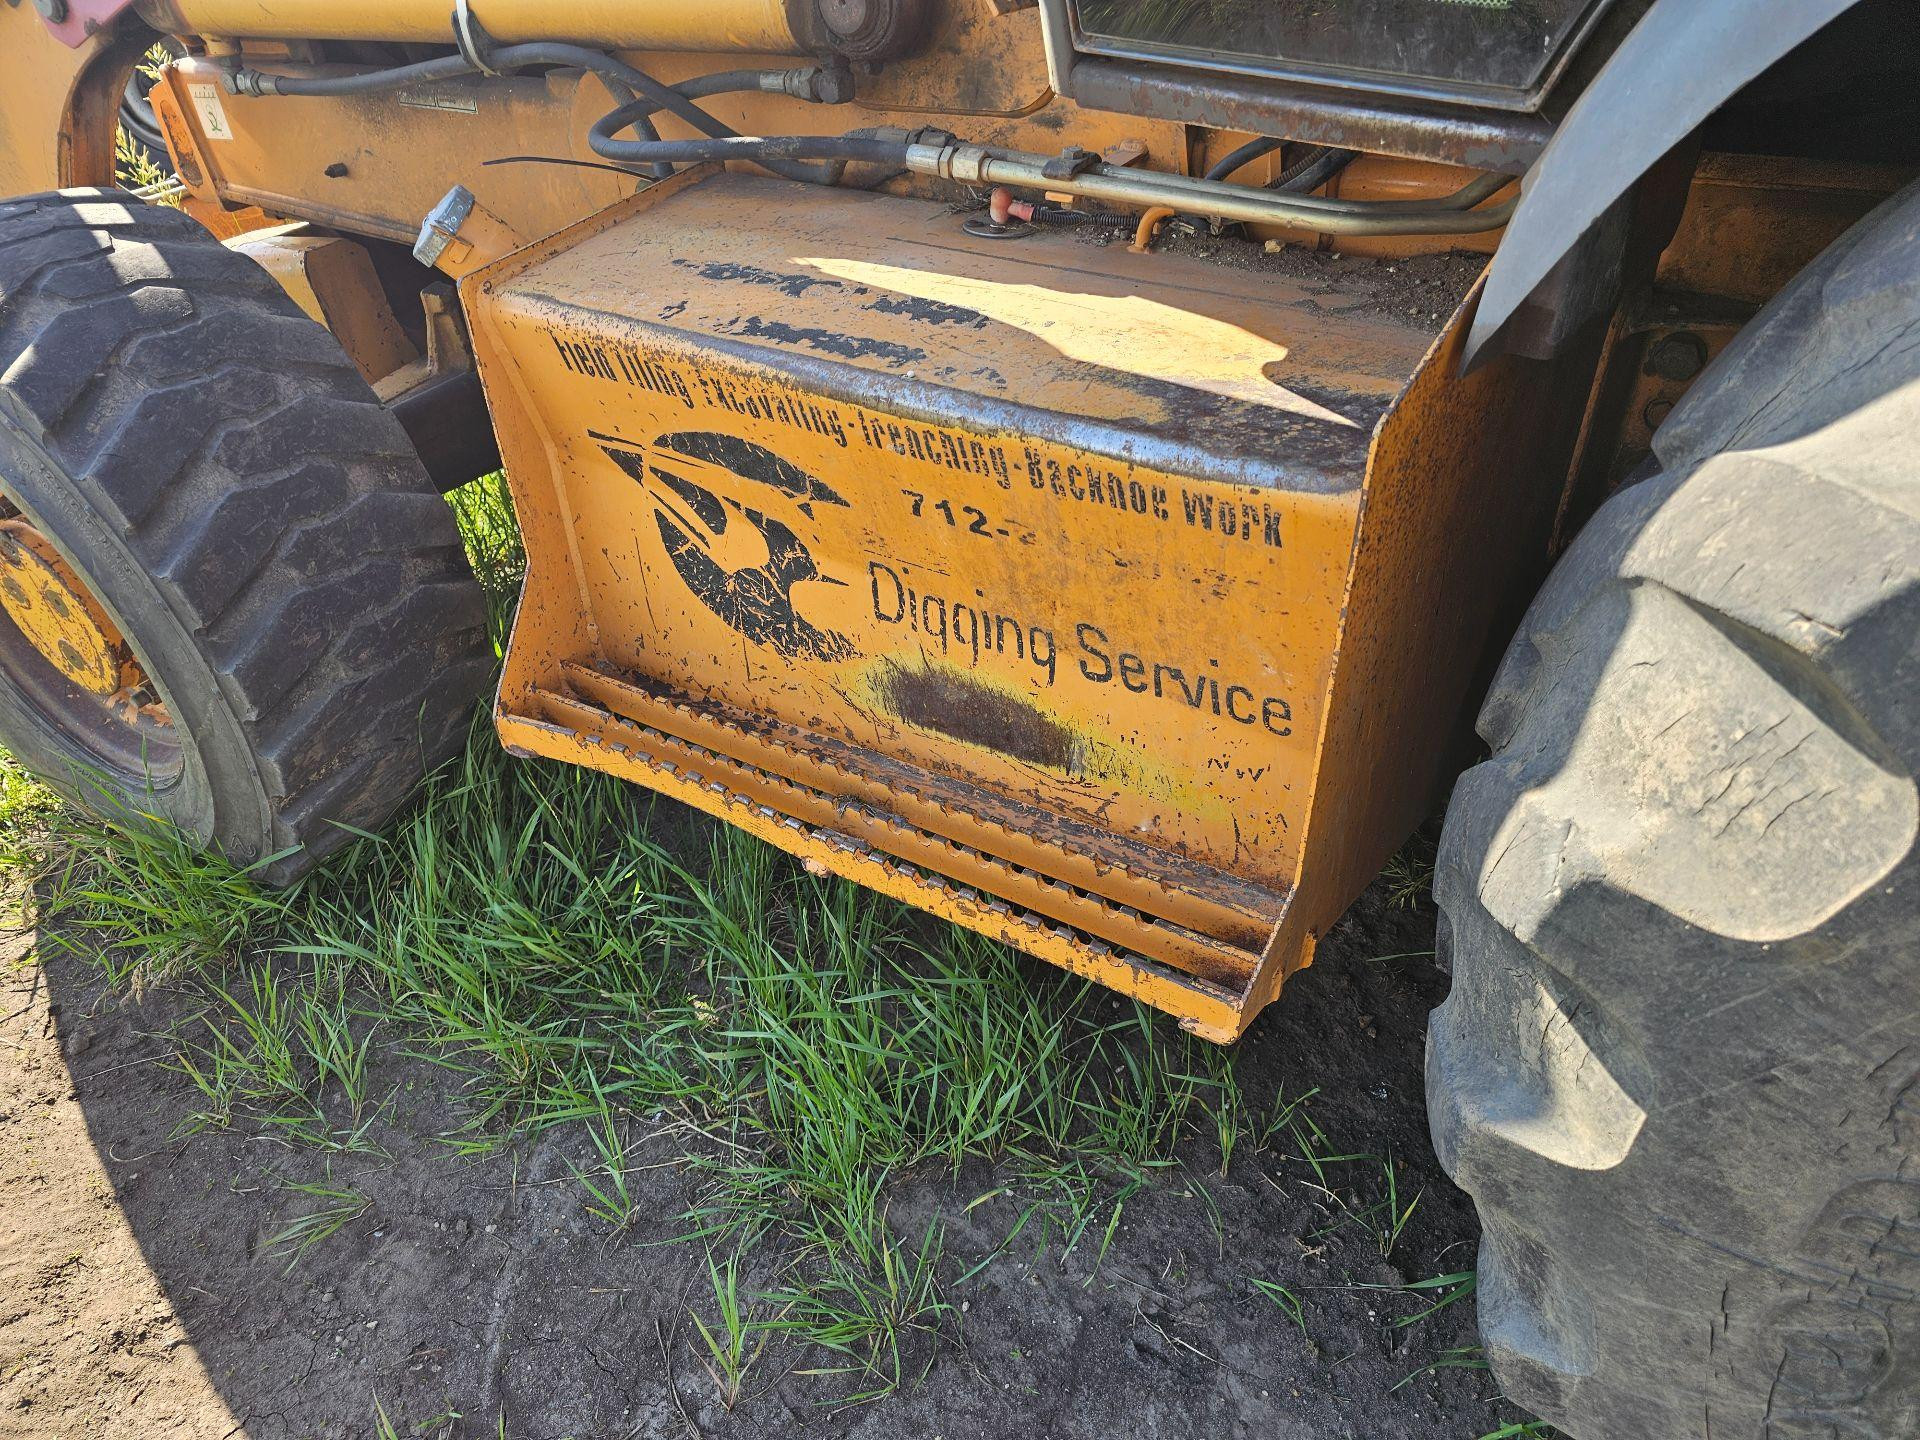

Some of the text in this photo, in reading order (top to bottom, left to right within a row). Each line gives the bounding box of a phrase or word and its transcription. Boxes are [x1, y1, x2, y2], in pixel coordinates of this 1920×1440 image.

[1182, 487, 1283, 549] Work
[868, 560, 1057, 689] Digging
[1075, 622, 1292, 737] Service
